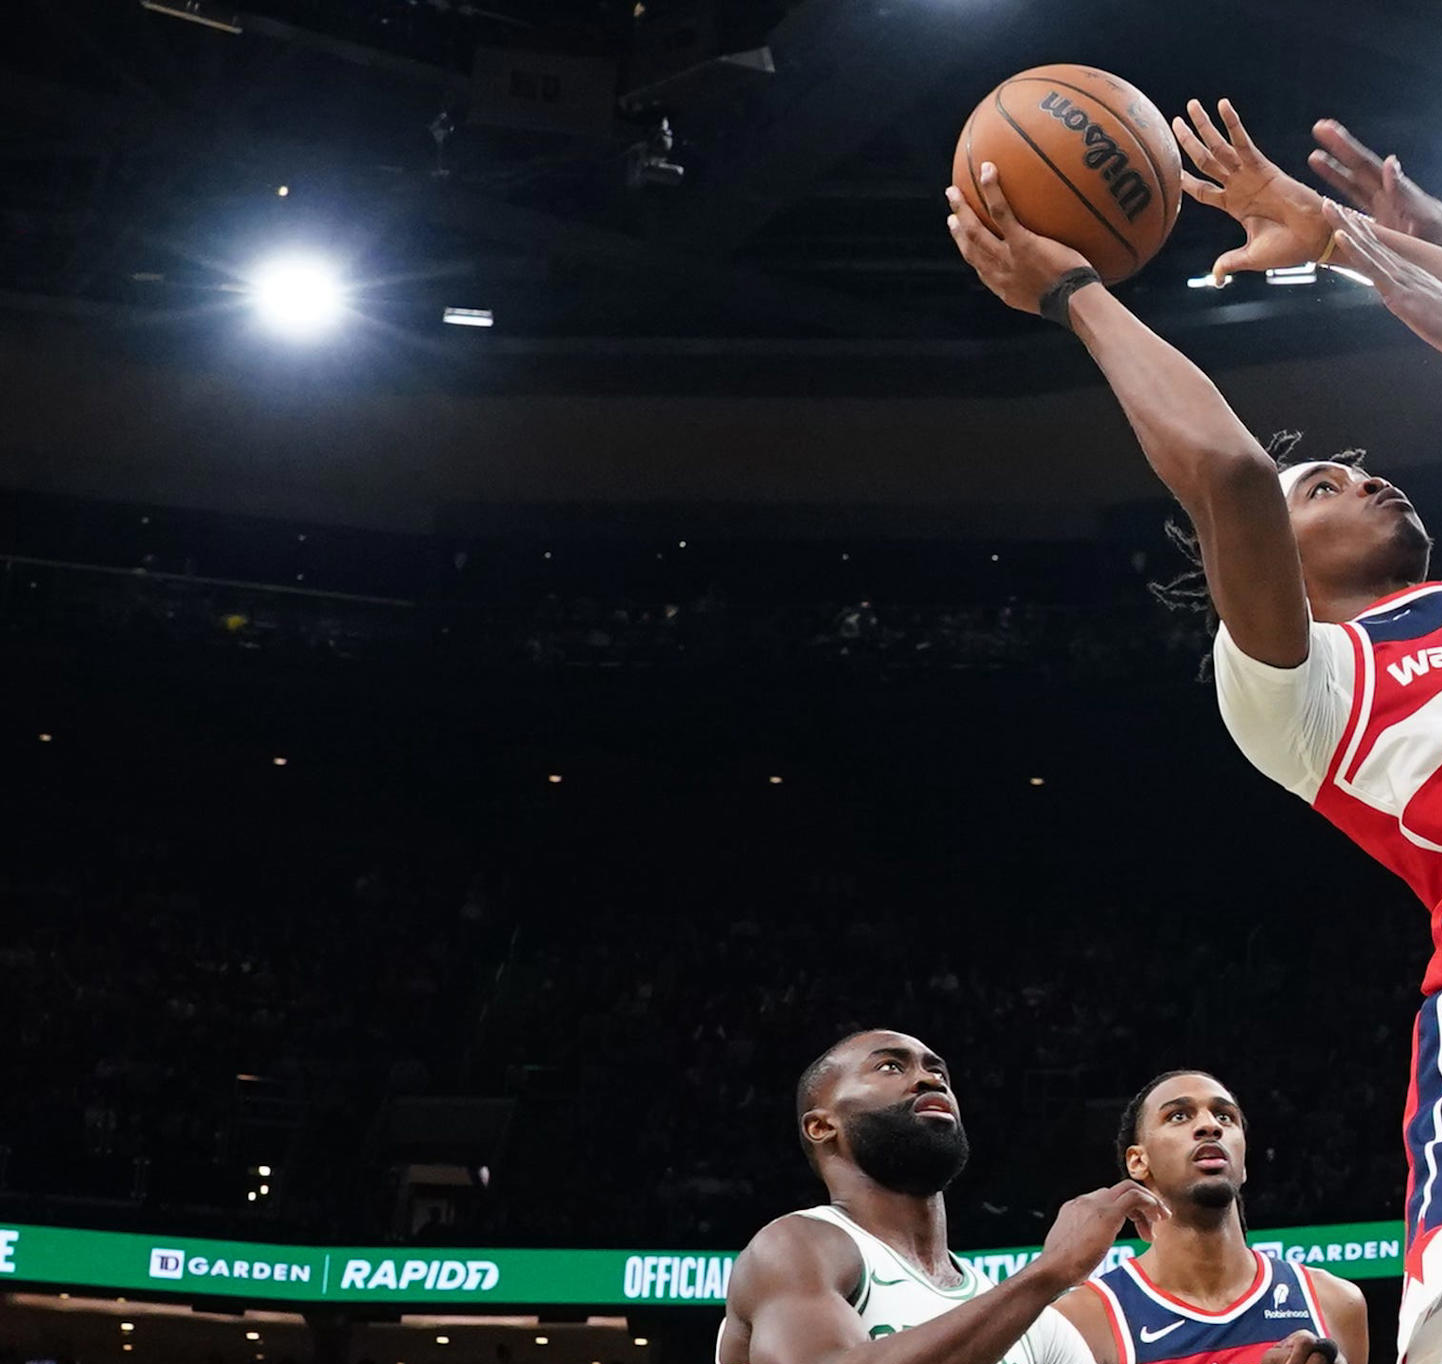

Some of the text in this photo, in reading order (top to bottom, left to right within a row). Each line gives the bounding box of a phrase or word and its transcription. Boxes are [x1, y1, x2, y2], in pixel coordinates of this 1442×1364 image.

[1038, 91, 1152, 224] Wilson
[1285, 1240, 1399, 1265] GARDEN
[187, 1256, 311, 1283] GARDEN
